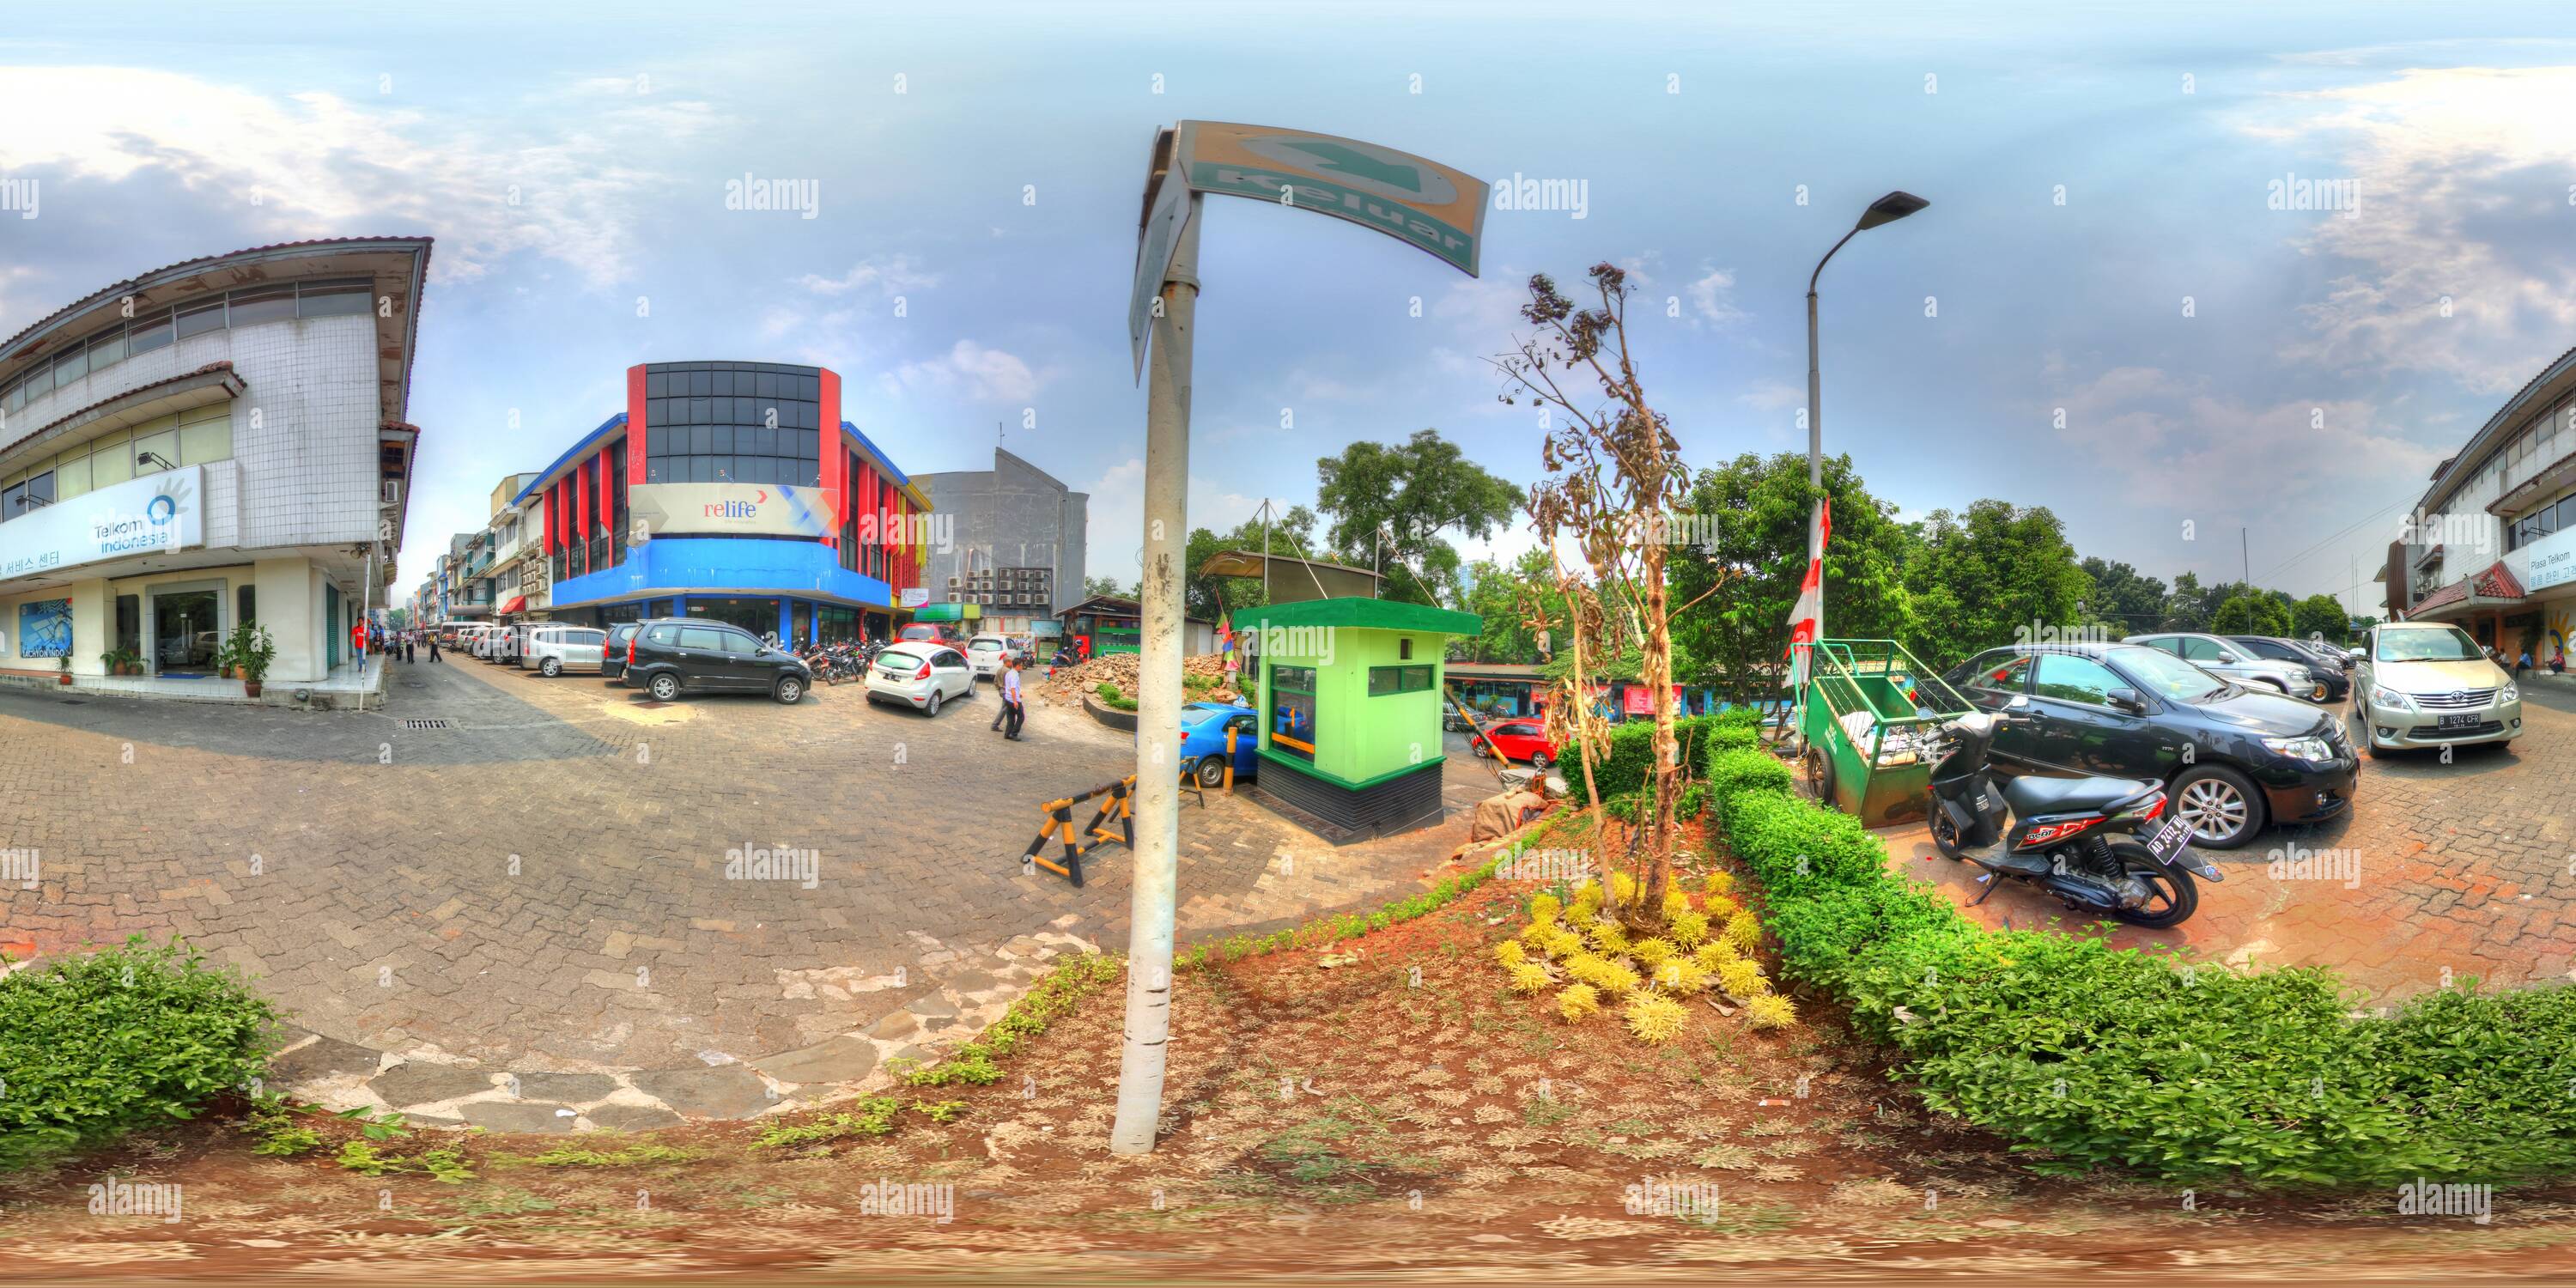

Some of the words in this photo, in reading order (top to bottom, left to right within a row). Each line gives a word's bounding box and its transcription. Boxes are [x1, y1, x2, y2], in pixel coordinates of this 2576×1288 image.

[1218, 169, 1463, 251] Keluar
[704, 501, 756, 518] relife
[94, 519, 143, 539] Telkom
[7, 557, 34, 574] 서비스
[39, 550, 59, 568] 센터
[2530, 560, 2547, 571] Plasa
[2548, 551, 2570, 565] Telkom
[2439, 716, 2445, 726] B
[2450, 715, 2464, 725] 1274
[2467, 714, 2479, 724] CFR
[2150, 841, 2165, 855] AD
[2160, 825, 2178, 845] 2412
